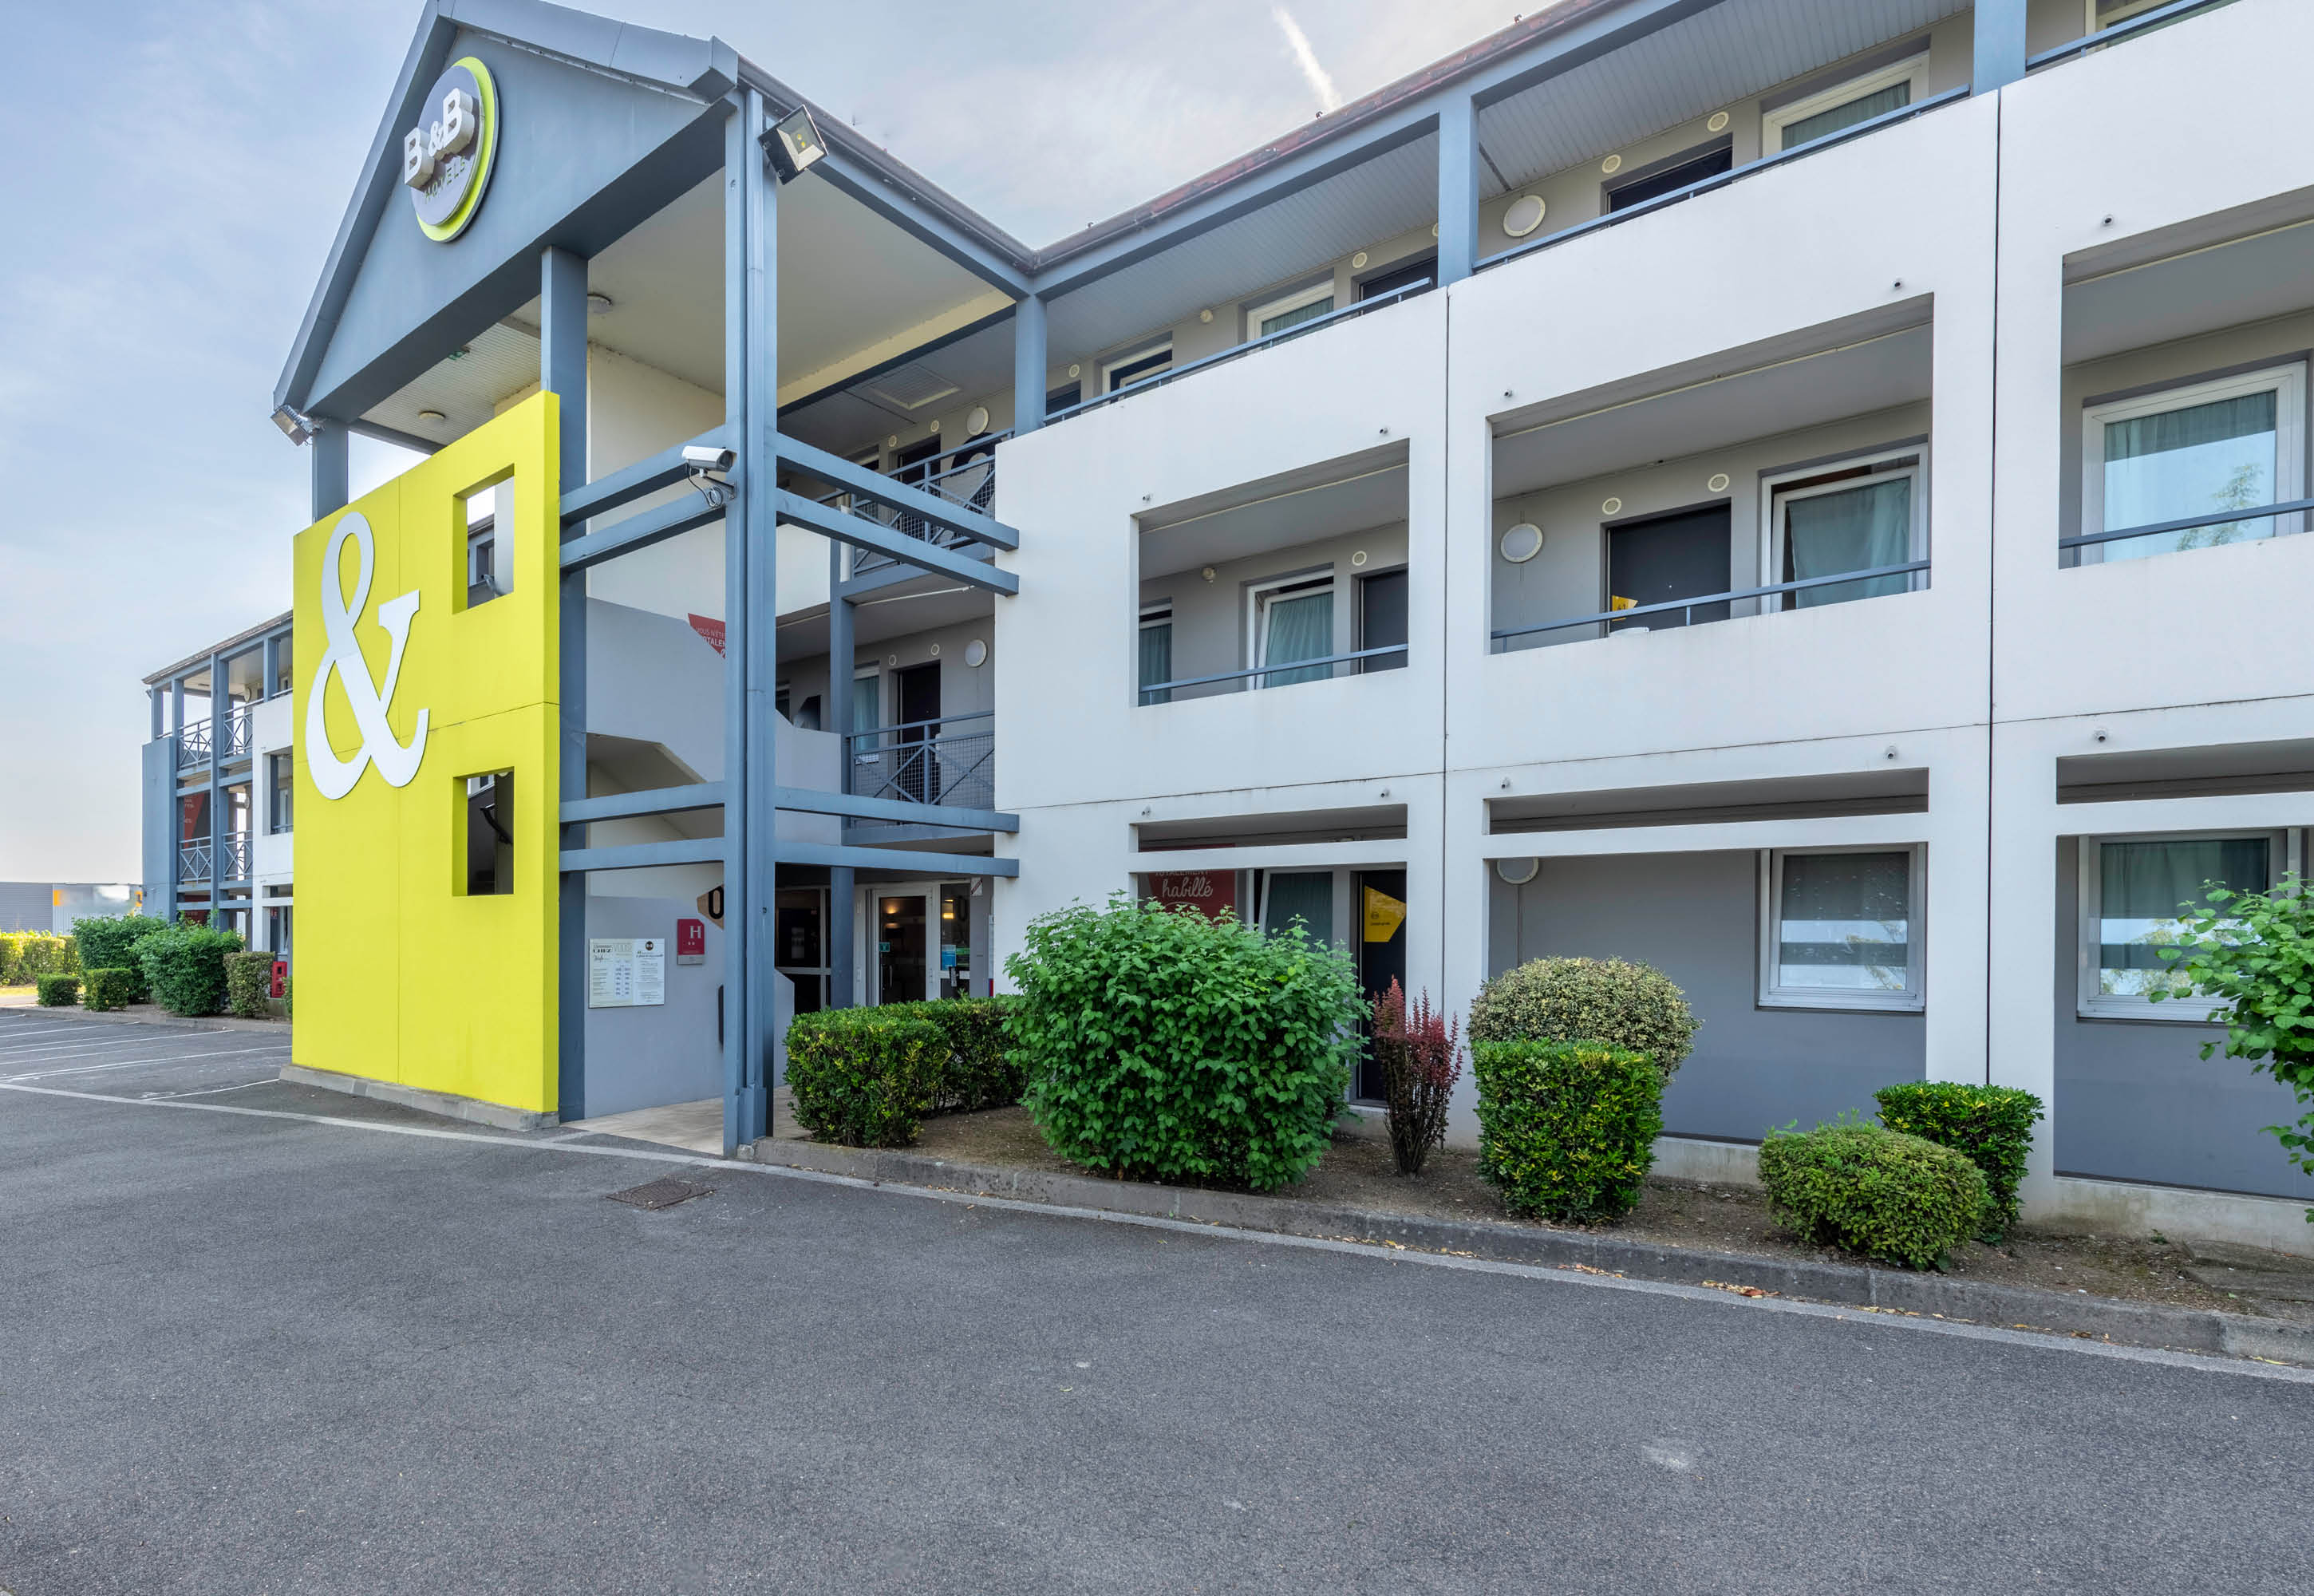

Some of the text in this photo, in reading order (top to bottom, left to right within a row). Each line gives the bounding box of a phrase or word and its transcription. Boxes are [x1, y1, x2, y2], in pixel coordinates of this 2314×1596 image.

[405, 88, 475, 190] B&B
[306, 512, 429, 800] &
[1162, 876, 1213, 898] habillé
[689, 926, 701, 938] H
